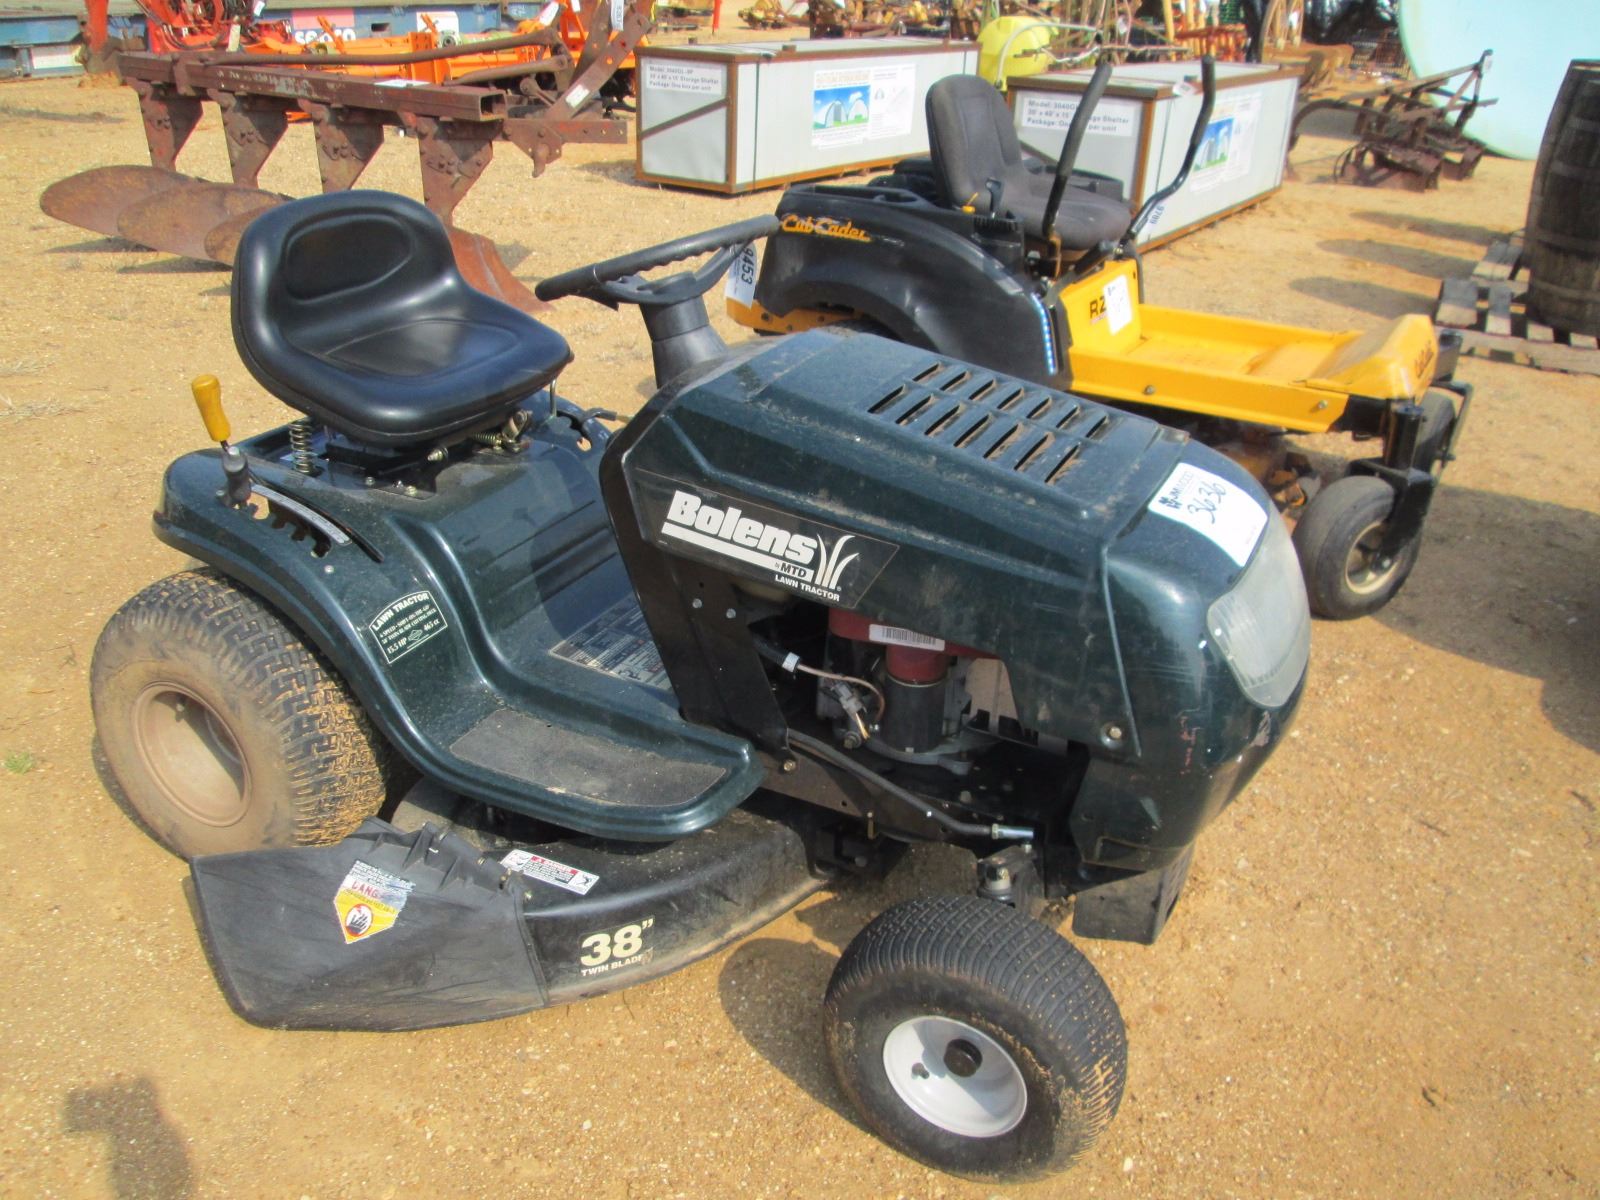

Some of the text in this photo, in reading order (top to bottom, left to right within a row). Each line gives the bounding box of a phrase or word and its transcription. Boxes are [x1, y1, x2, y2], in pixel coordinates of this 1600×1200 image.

[741, 248, 754, 285] 9453
[667, 490, 818, 565] Bolens
[780, 562, 808, 579] MTD
[775, 574, 840, 602] LAWN TRACTOR
[371, 592, 430, 631] LAWN TRACTOR
[398, 637, 407, 647] HP
[580, 964, 609, 977] TWIN
